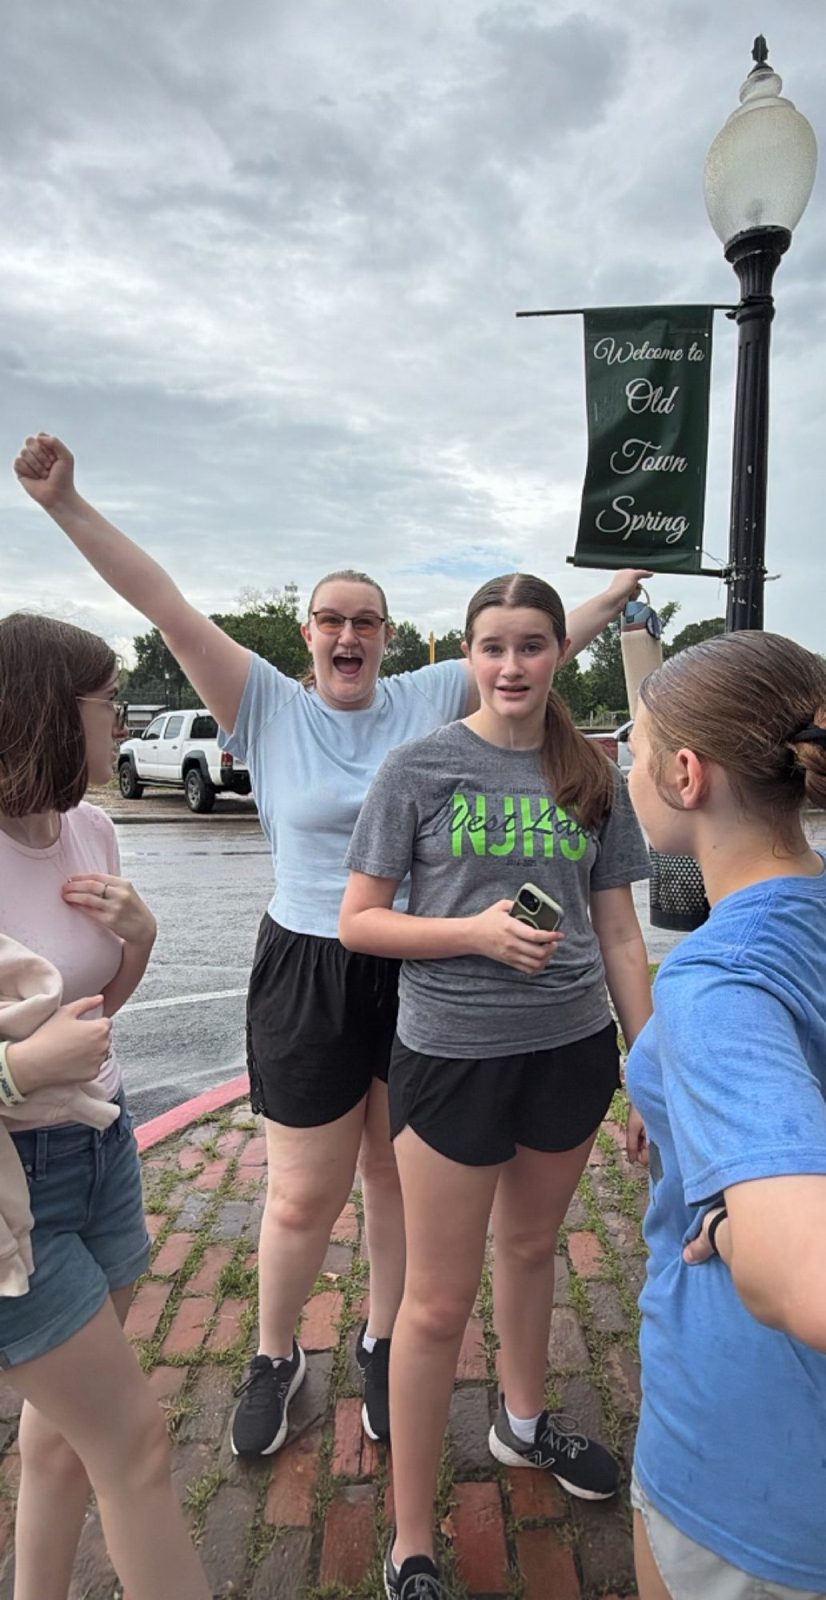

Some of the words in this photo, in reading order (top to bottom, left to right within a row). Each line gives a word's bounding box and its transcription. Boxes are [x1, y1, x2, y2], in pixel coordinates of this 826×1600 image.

[593, 337, 684, 365] Welcome
[687, 342, 705, 362] to
[625, 377, 680, 415] Old
[609, 438, 688, 475] Town
[595, 495, 690, 544] Spring
[431, 803, 518, 836] West
[451, 792, 588, 861] NJHS
